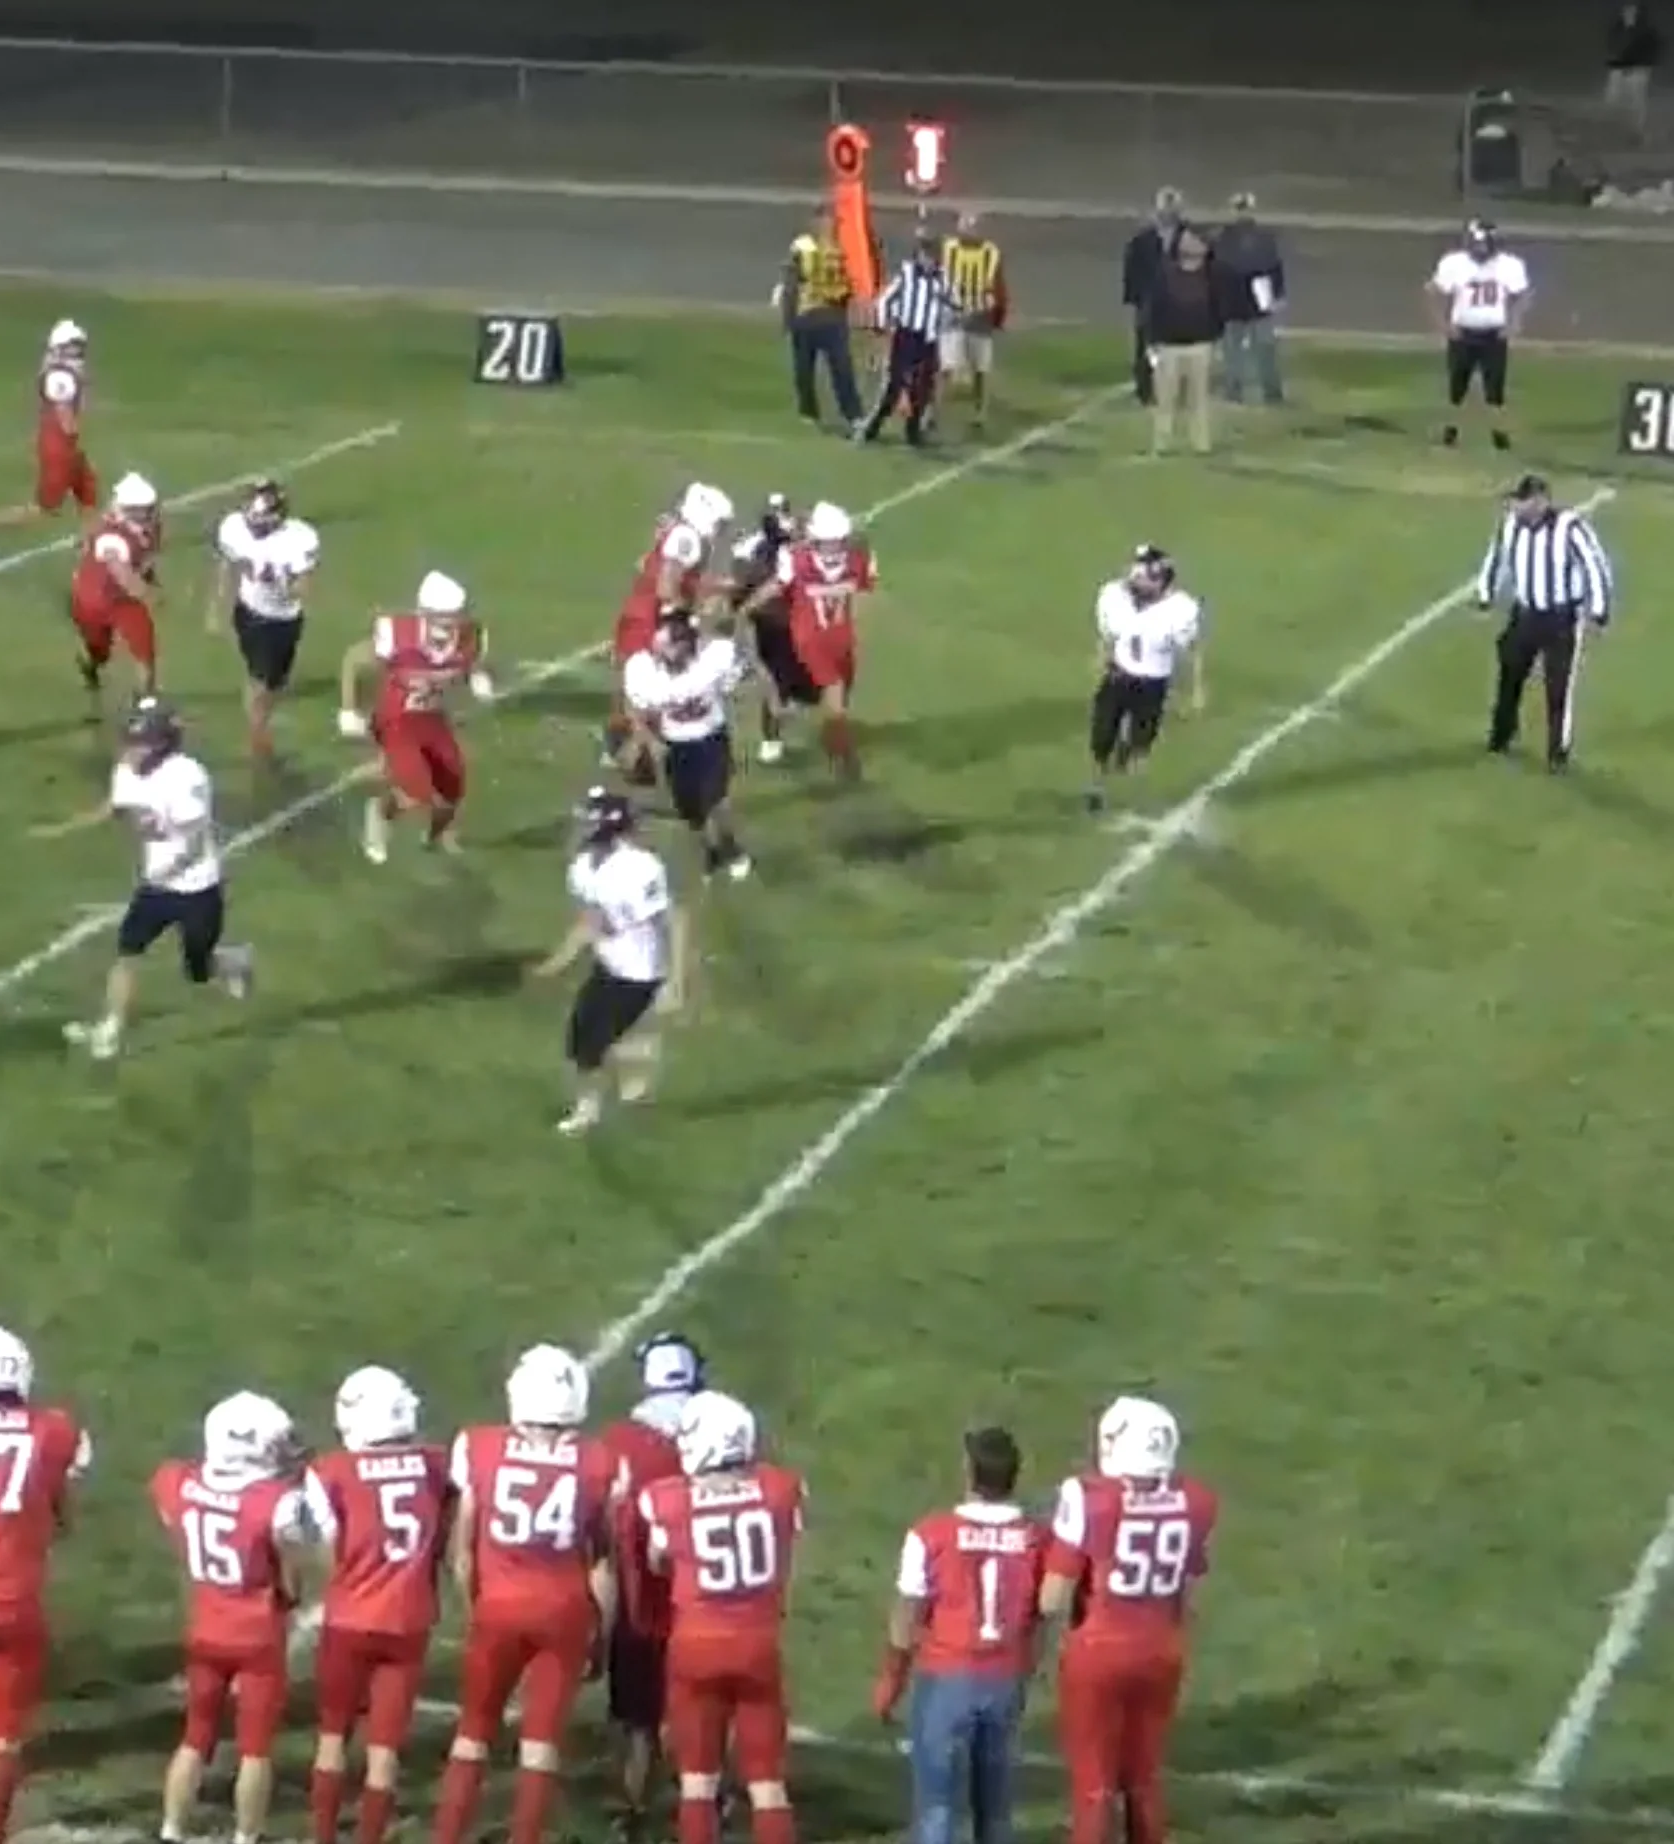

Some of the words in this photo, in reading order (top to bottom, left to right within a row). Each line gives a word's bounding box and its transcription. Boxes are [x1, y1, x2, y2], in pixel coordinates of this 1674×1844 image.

[481, 322, 548, 381] 20
[1629, 388, 1674, 451] 3
[181, 1506, 242, 1585] 15
[379, 1483, 420, 1562] 5
[489, 1467, 578, 1549] 54
[691, 1511, 774, 1592] 50
[1108, 1520, 1190, 1595] 59
[980, 1557, 1001, 1641] 1
